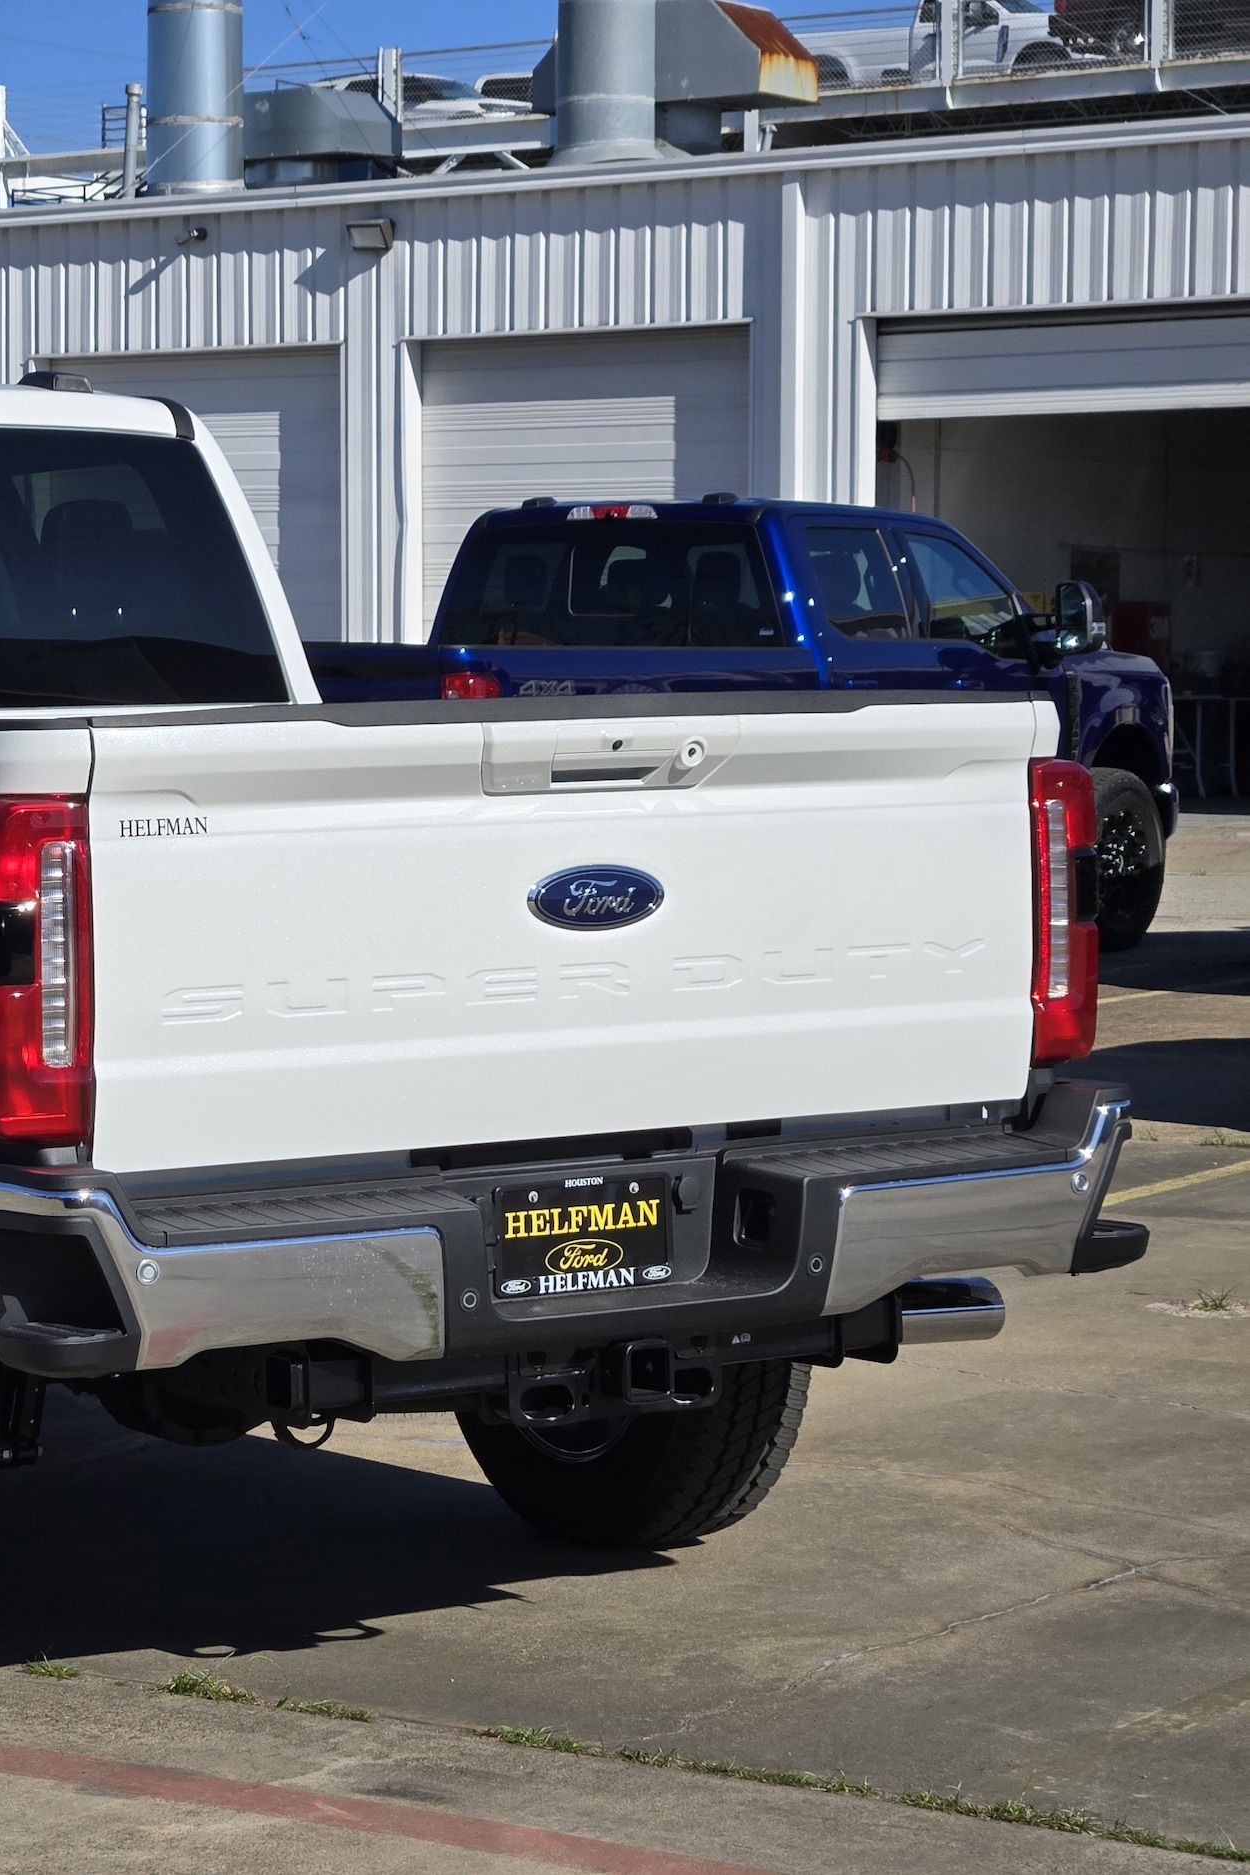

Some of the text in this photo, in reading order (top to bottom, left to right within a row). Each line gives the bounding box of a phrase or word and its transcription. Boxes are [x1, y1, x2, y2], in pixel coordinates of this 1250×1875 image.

[119, 816, 208, 838] HELFMAN
[161, 938, 985, 1026] SUPER DUTY
[564, 1176, 604, 1188] HOUSTON
[504, 1198, 661, 1239] HELFMAN
[538, 1267, 636, 1294] HELFMAN
